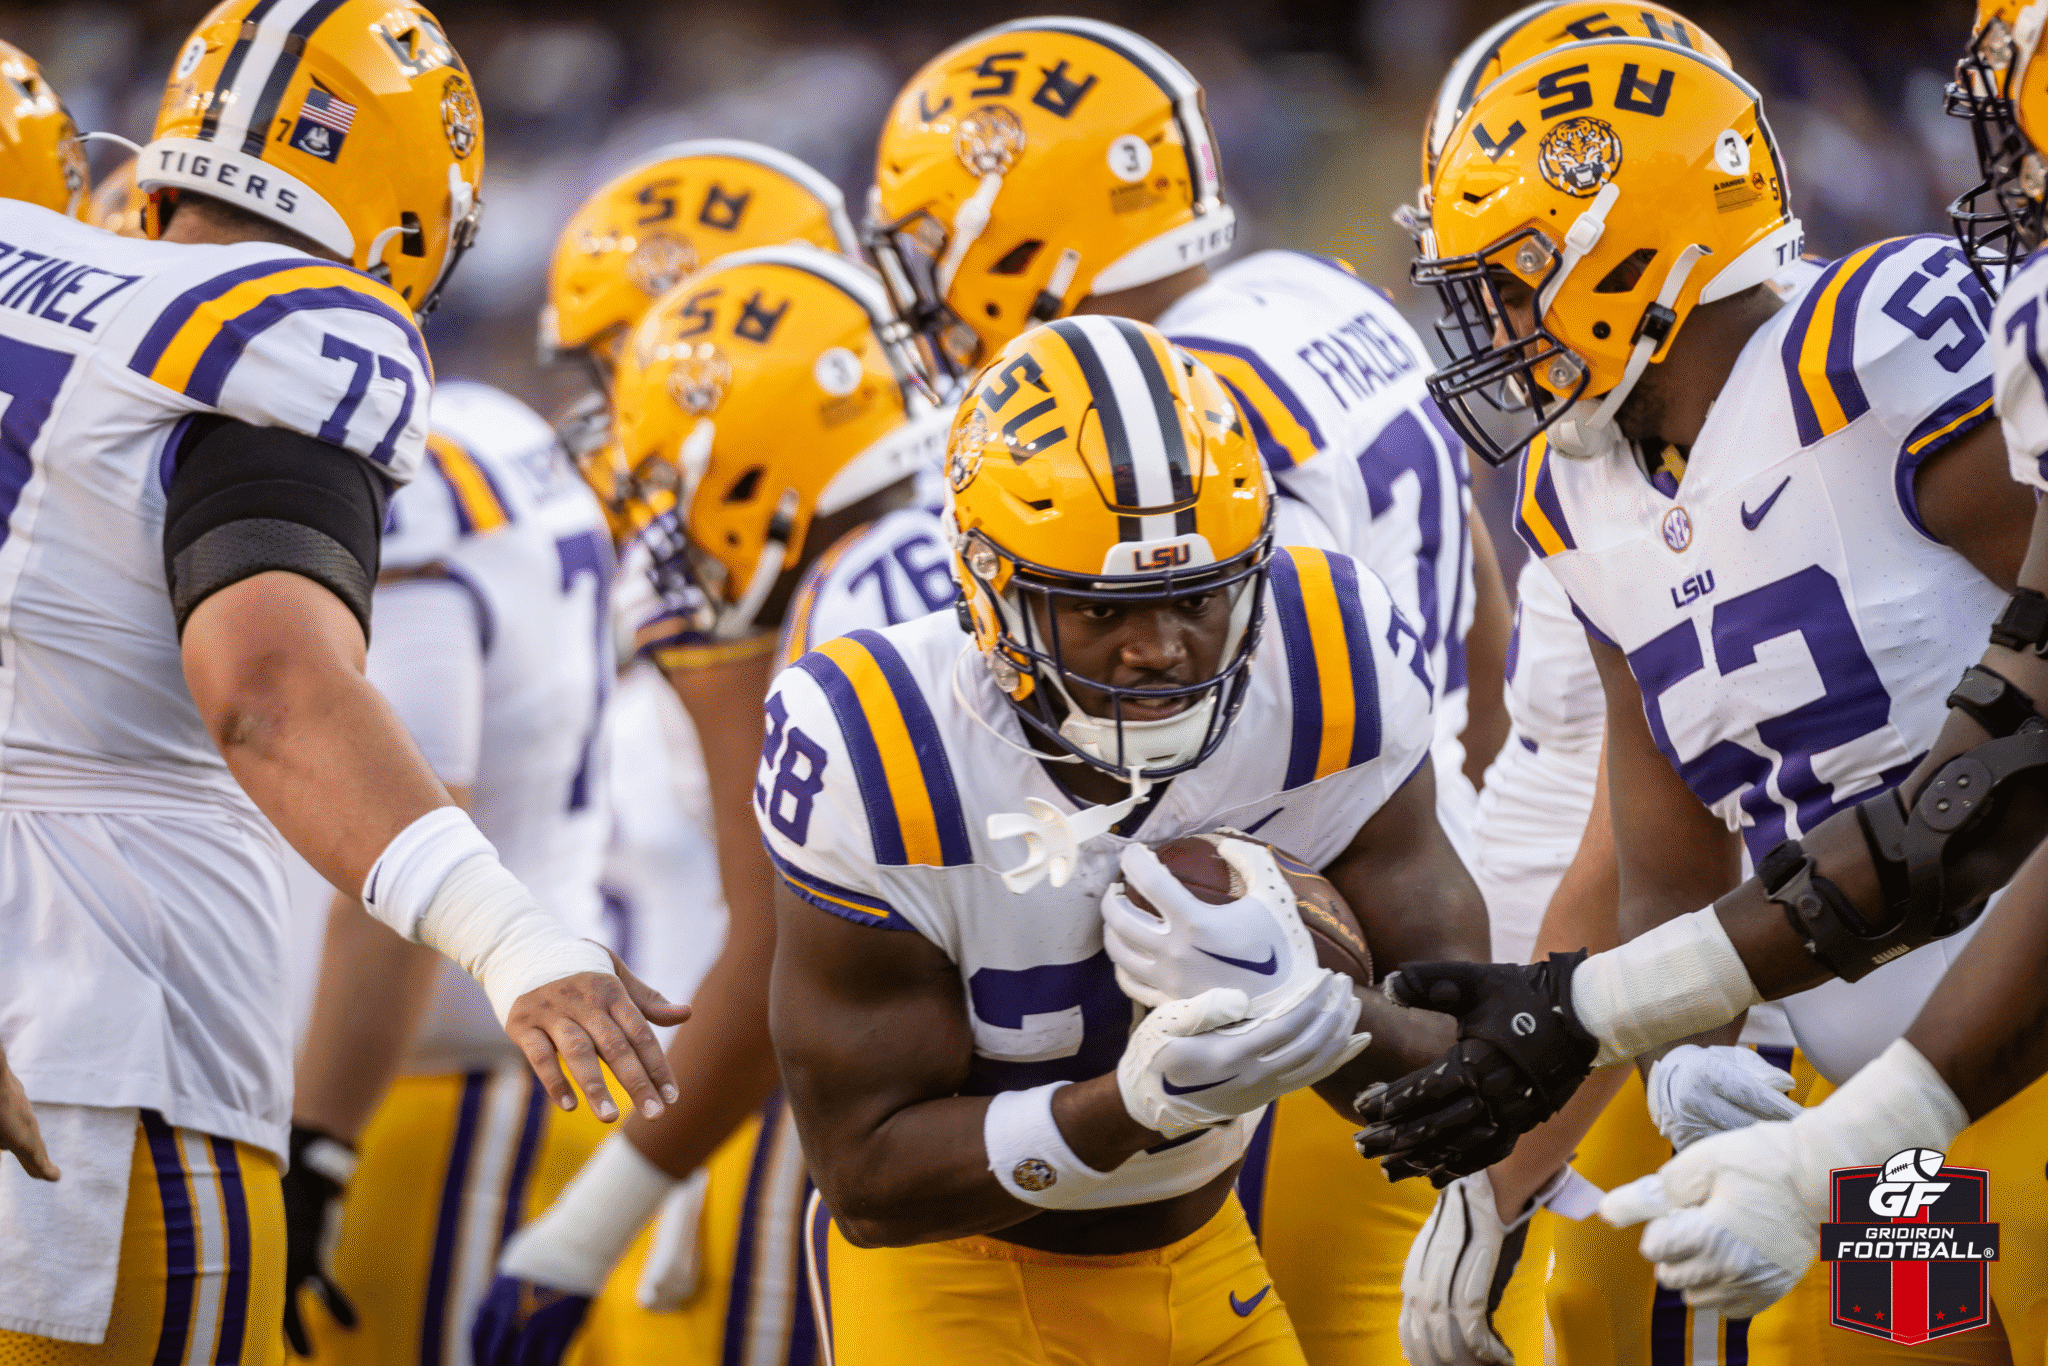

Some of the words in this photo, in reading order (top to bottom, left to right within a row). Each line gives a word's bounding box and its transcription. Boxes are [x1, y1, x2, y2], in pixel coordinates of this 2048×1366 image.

[274, 117, 292, 142] 7
[159, 150, 299, 214] TIGERS
[320, 332, 418, 467] 77
[848, 534, 955, 626] 76
[1132, 543, 1192, 572] LSU
[1670, 569, 1715, 608] LSU
[1626, 563, 1930, 872] 52
